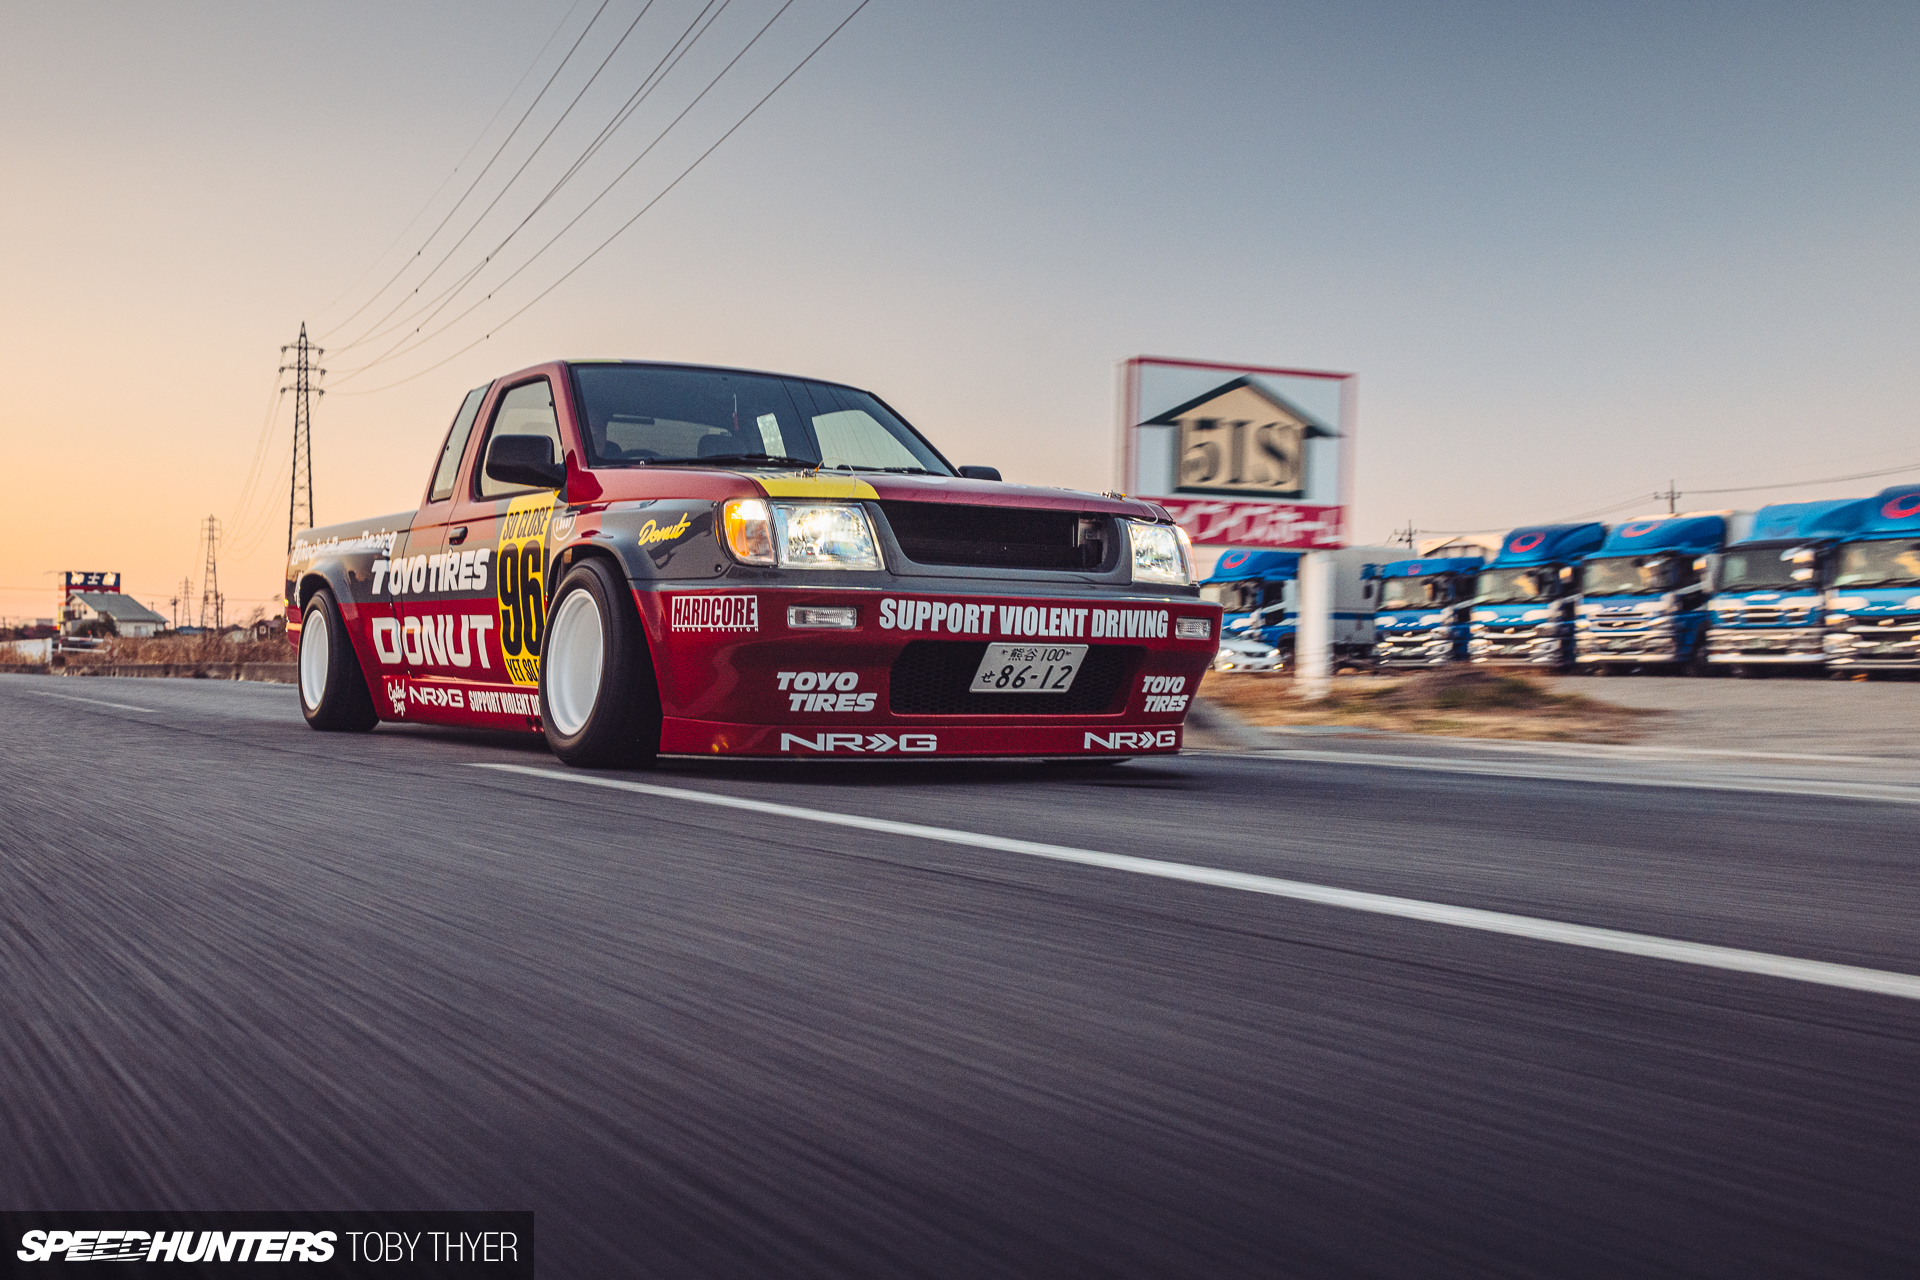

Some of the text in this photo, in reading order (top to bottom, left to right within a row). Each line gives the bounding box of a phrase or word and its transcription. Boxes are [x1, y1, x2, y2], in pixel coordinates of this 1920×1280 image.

[503, 512, 520, 540] SO
[517, 506, 551, 538] CLOSE
[638, 513, 691, 546] Donut
[372, 548, 491, 596] TOYO TIRES
[500, 540, 543, 656] 96
[672, 597, 757, 627] HARDCORE
[879, 598, 1169, 638] SUPPORT VIOLENT DRIVING
[371, 614, 494, 669] DONUT
[1008, 648, 1066, 661] 熊谷 100
[506, 658, 526, 682] YET
[776, 671, 859, 691] TOYO
[981, 664, 1073, 689] せ 86-12
[1142, 675, 1185, 694] TOYO
[468, 690, 501, 713] SUPPORT
[500, 692, 531, 716] VIOLENT
[788, 693, 877, 712] TIRES
[1143, 695, 1189, 712] TIRES
